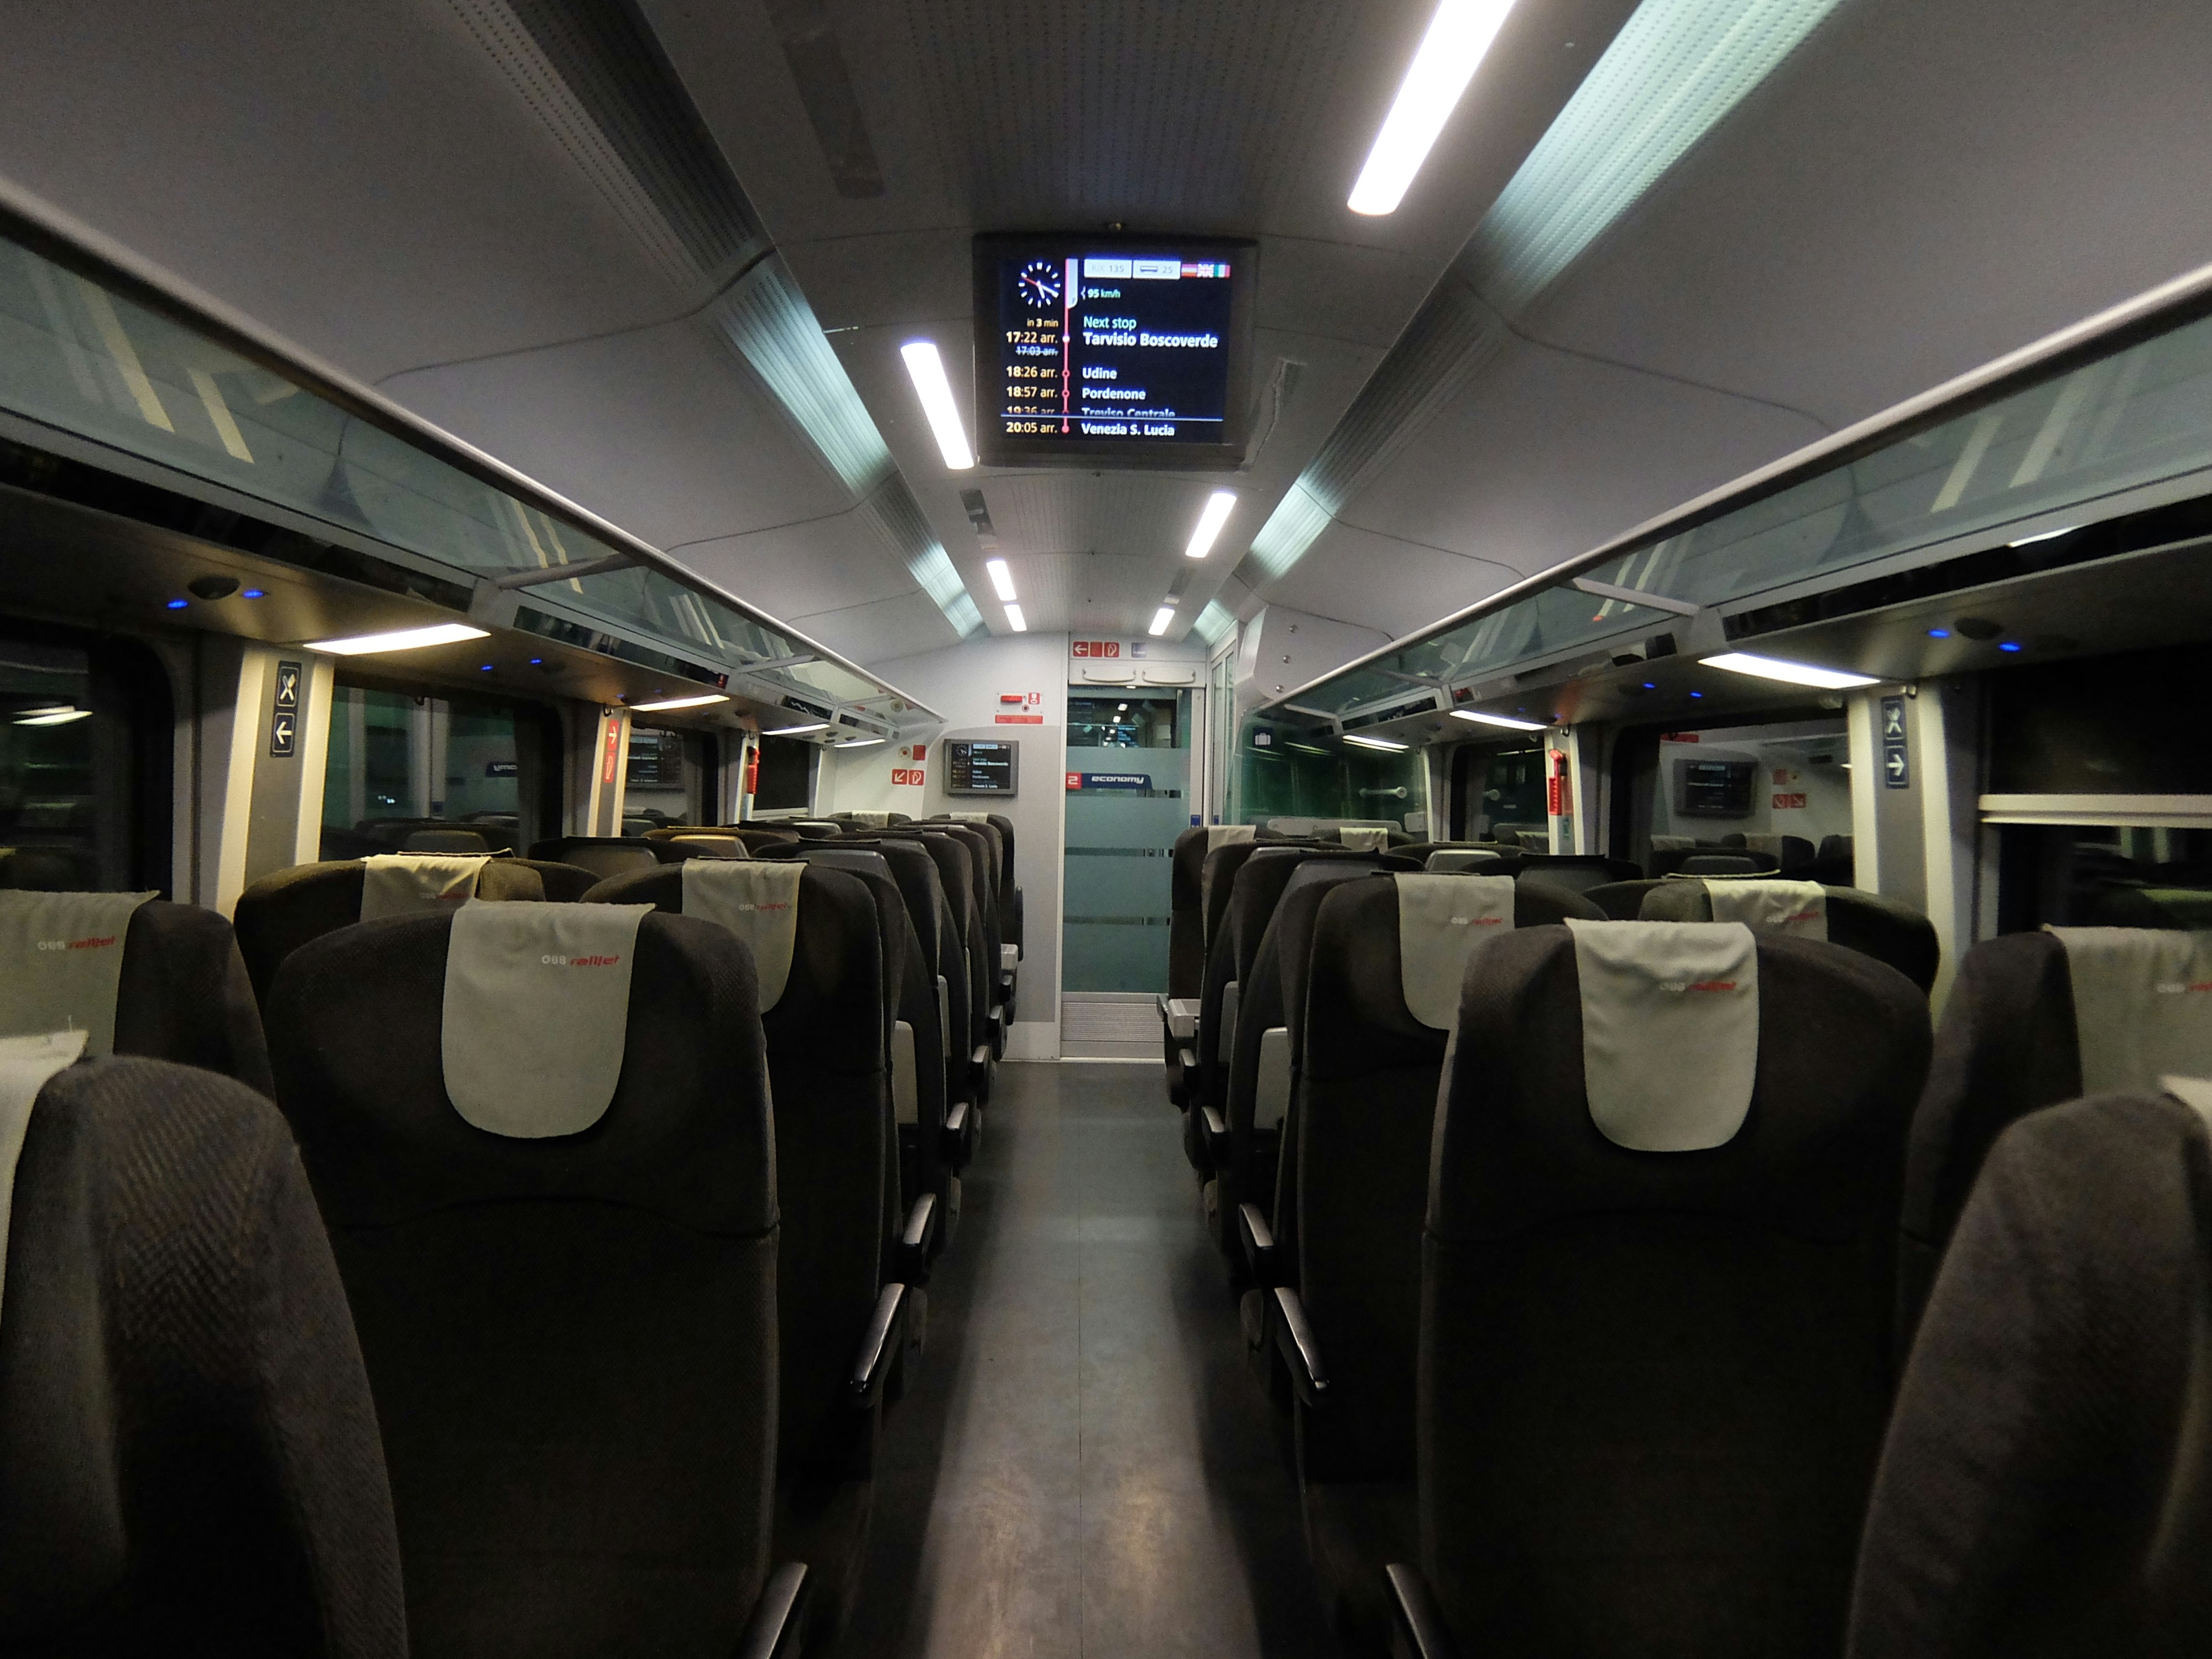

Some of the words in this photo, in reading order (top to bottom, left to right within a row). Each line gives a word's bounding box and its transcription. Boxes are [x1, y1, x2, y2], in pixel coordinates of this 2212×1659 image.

[1087, 289, 1099, 298] 95
[1100, 289, 1121, 298] km/h
[1026, 319, 1034, 327] in
[1036, 318, 1042, 327] 3
[1044, 319, 1059, 327] min
[1083, 316, 1109, 328] Next
[1112, 317, 1137, 331] stop
[1006, 331, 1037, 343] 17:22
[1040, 334, 1058, 343] arr.
[1082, 332, 1137, 346] Tarvisio
[1140, 332, 1218, 348] Boscoverde
[1006, 366, 1037, 378] 18:26
[1040, 368, 1058, 378] arr.
[1082, 367, 1118, 379] Udine
[1006, 386, 1037, 398] 18:57
[1040, 388, 1058, 398] arr.
[1082, 387, 1146, 400] Pordenone
[1006, 422, 1037, 433] 20:05
[1040, 424, 1058, 434] arr.
[1081, 422, 1128, 435] Venezia
[1130, 424, 1141, 436] S.
[1144, 425, 1175, 436] Lucia
[1068, 775, 1078, 785] 2
[1091, 776, 1144, 784] economy
[570, 954, 620, 967] railjet
